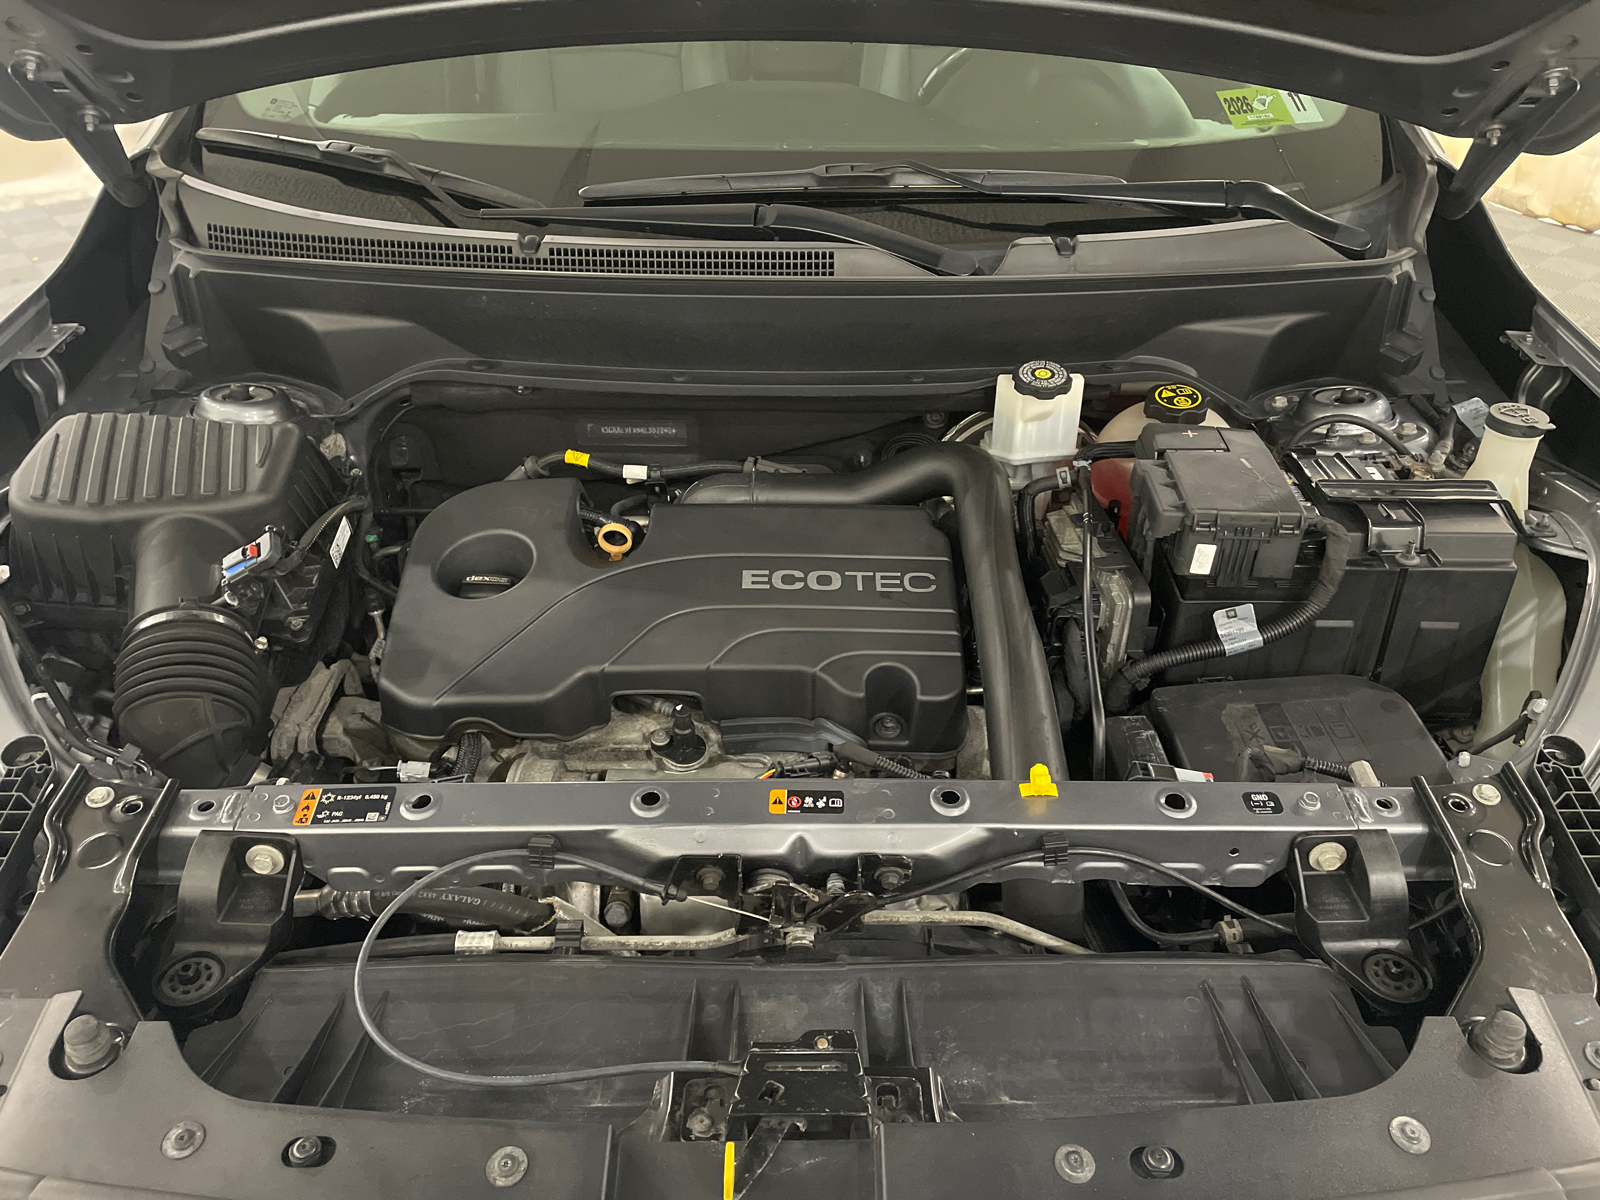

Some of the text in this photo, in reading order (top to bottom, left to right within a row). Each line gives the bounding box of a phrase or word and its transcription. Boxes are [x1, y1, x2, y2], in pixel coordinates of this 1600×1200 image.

[1223, 95, 1254, 115] 2026
[741, 569, 937, 593] ECOTEC
[1250, 793, 1269, 801] GND
[439, 893, 482, 906] GALAXY
